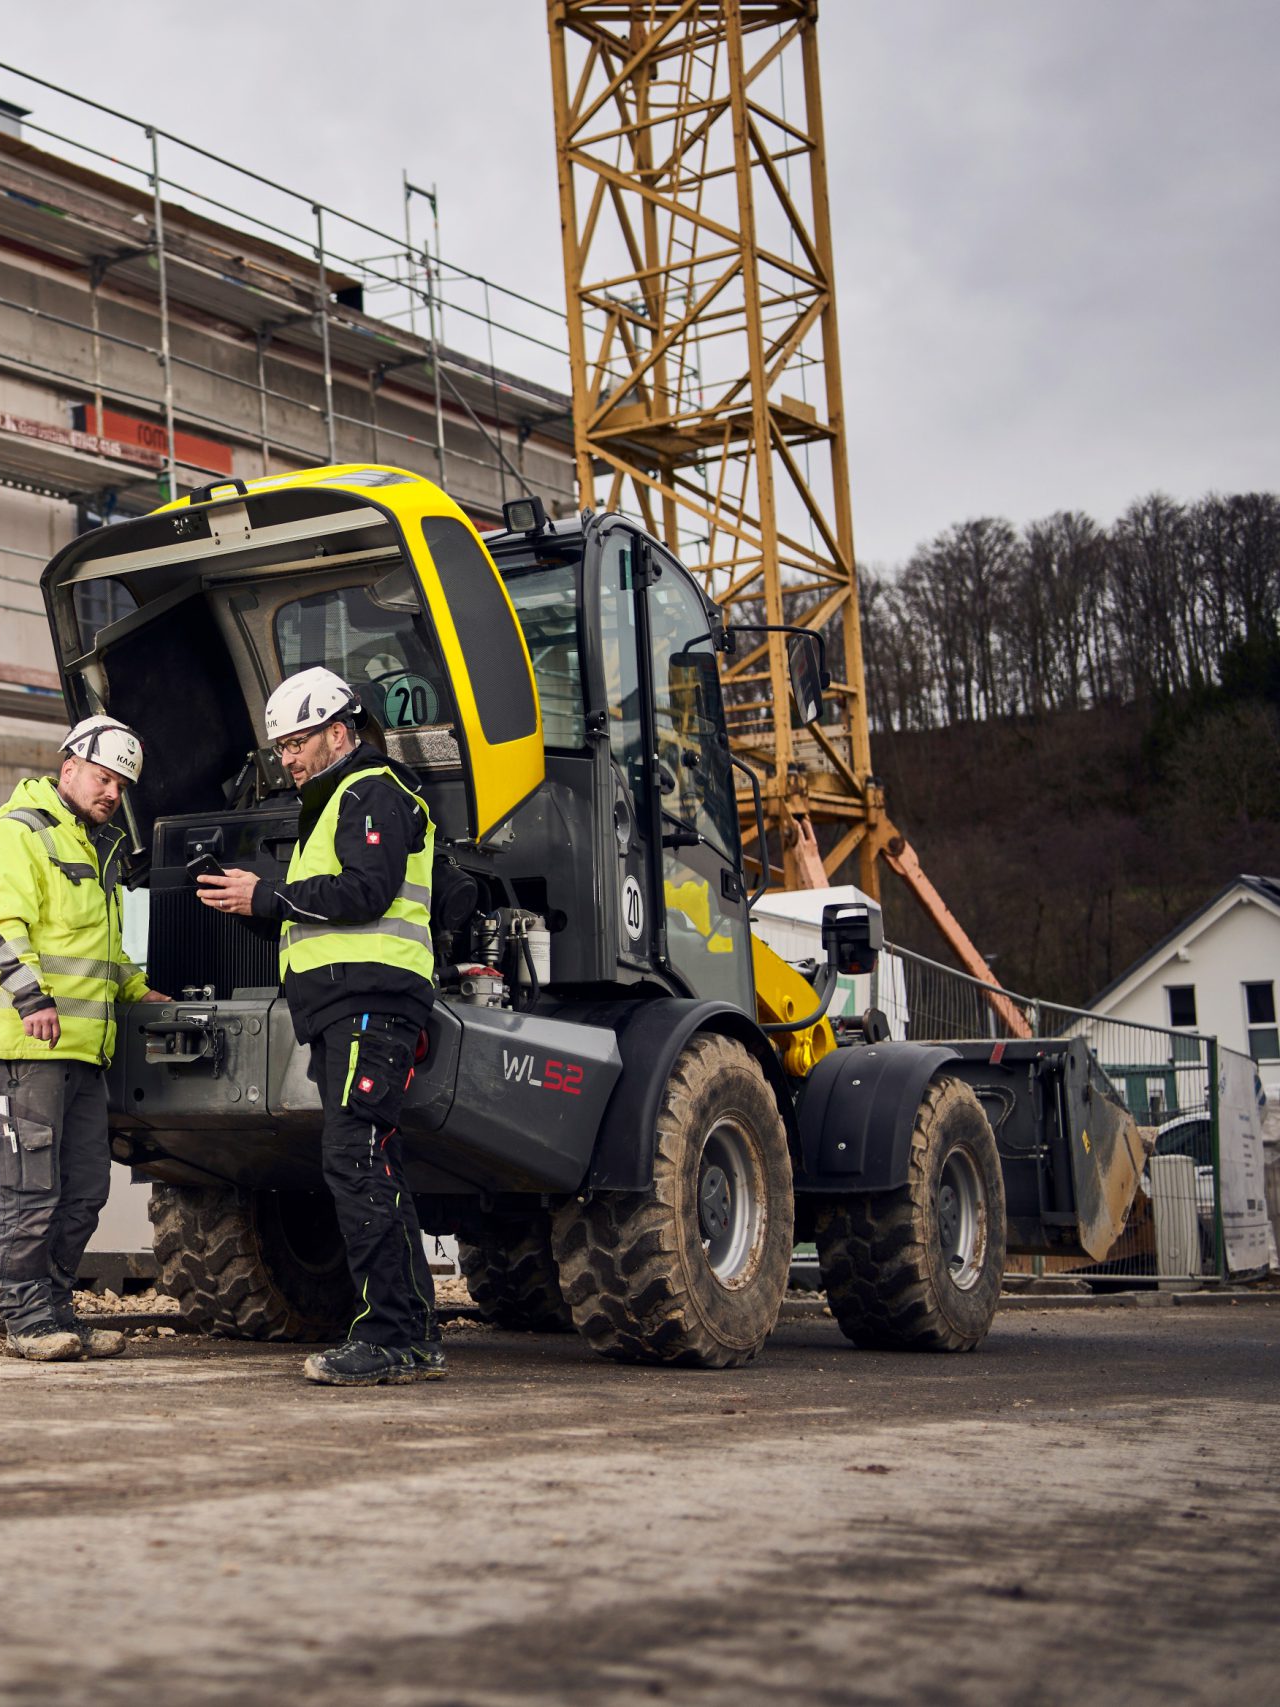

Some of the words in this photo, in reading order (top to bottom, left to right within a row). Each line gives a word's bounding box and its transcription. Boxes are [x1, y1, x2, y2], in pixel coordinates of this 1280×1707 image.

[137, 422, 169, 450] rom
[395, 686, 428, 726] 20
[116, 754, 137, 770] KASK
[626, 886, 640, 930] 20
[503, 1050, 583, 1095] WL52
